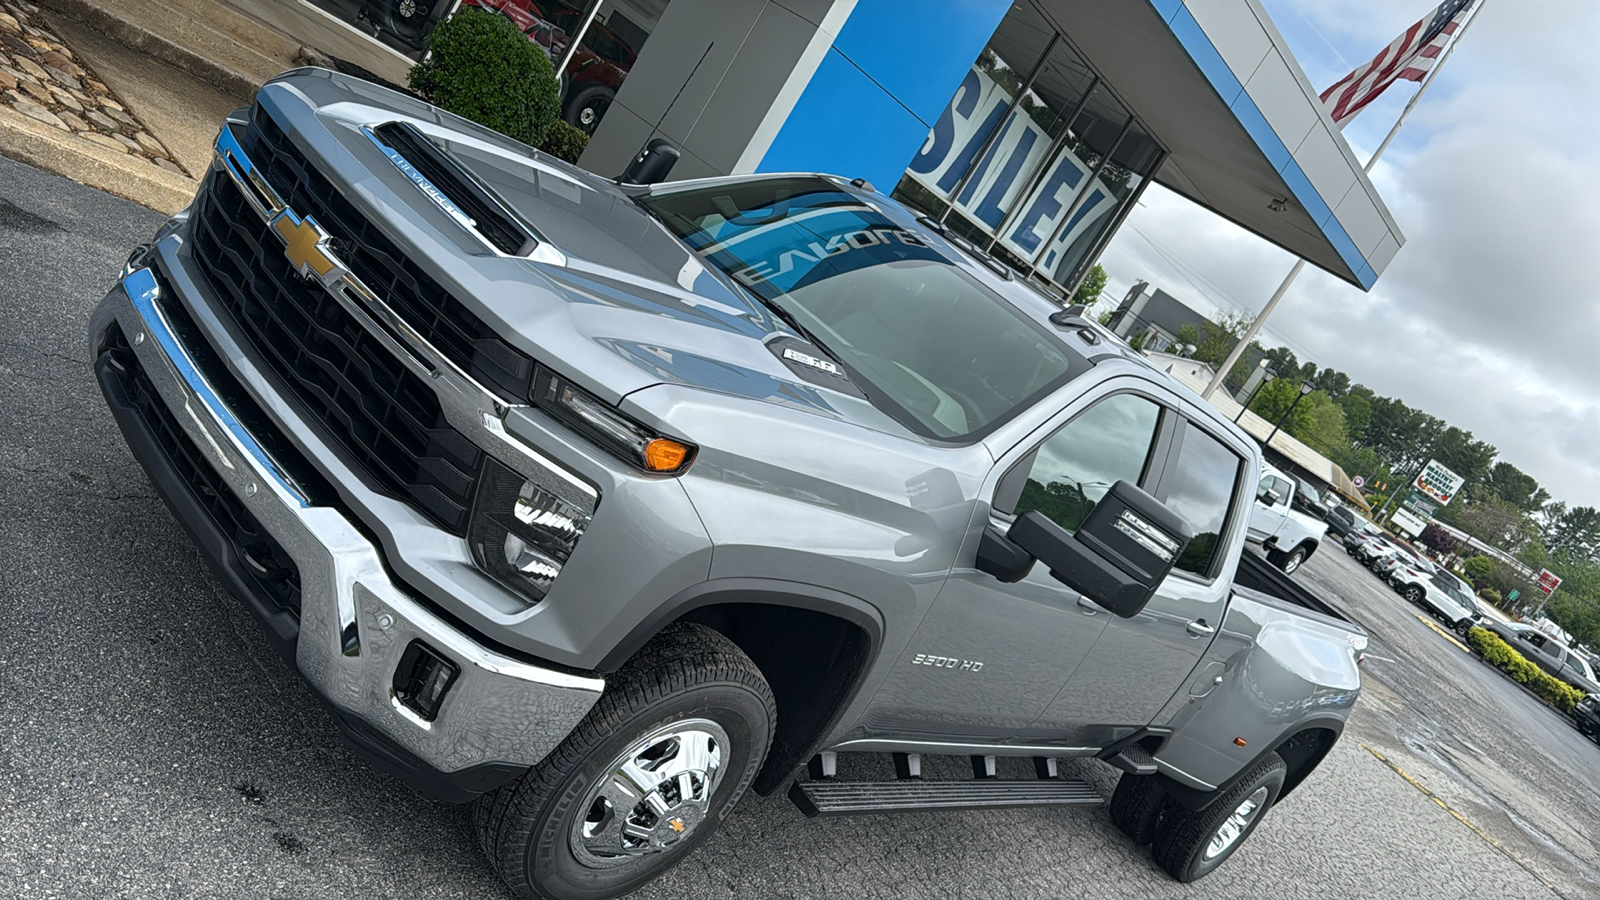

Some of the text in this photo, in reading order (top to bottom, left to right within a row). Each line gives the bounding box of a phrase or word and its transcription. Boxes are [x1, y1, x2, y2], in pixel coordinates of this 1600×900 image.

[909, 67, 1105, 269] SALE!
[391, 154, 457, 213] CHEVROLET
[1426, 465, 1454, 484] HEALTHY
[1426, 472, 1454, 491] HARVEST
[1424, 478, 1453, 498] PRODUCE
[911, 653, 984, 672] 3500 HD
[540, 778, 584, 859] MICHELIN
